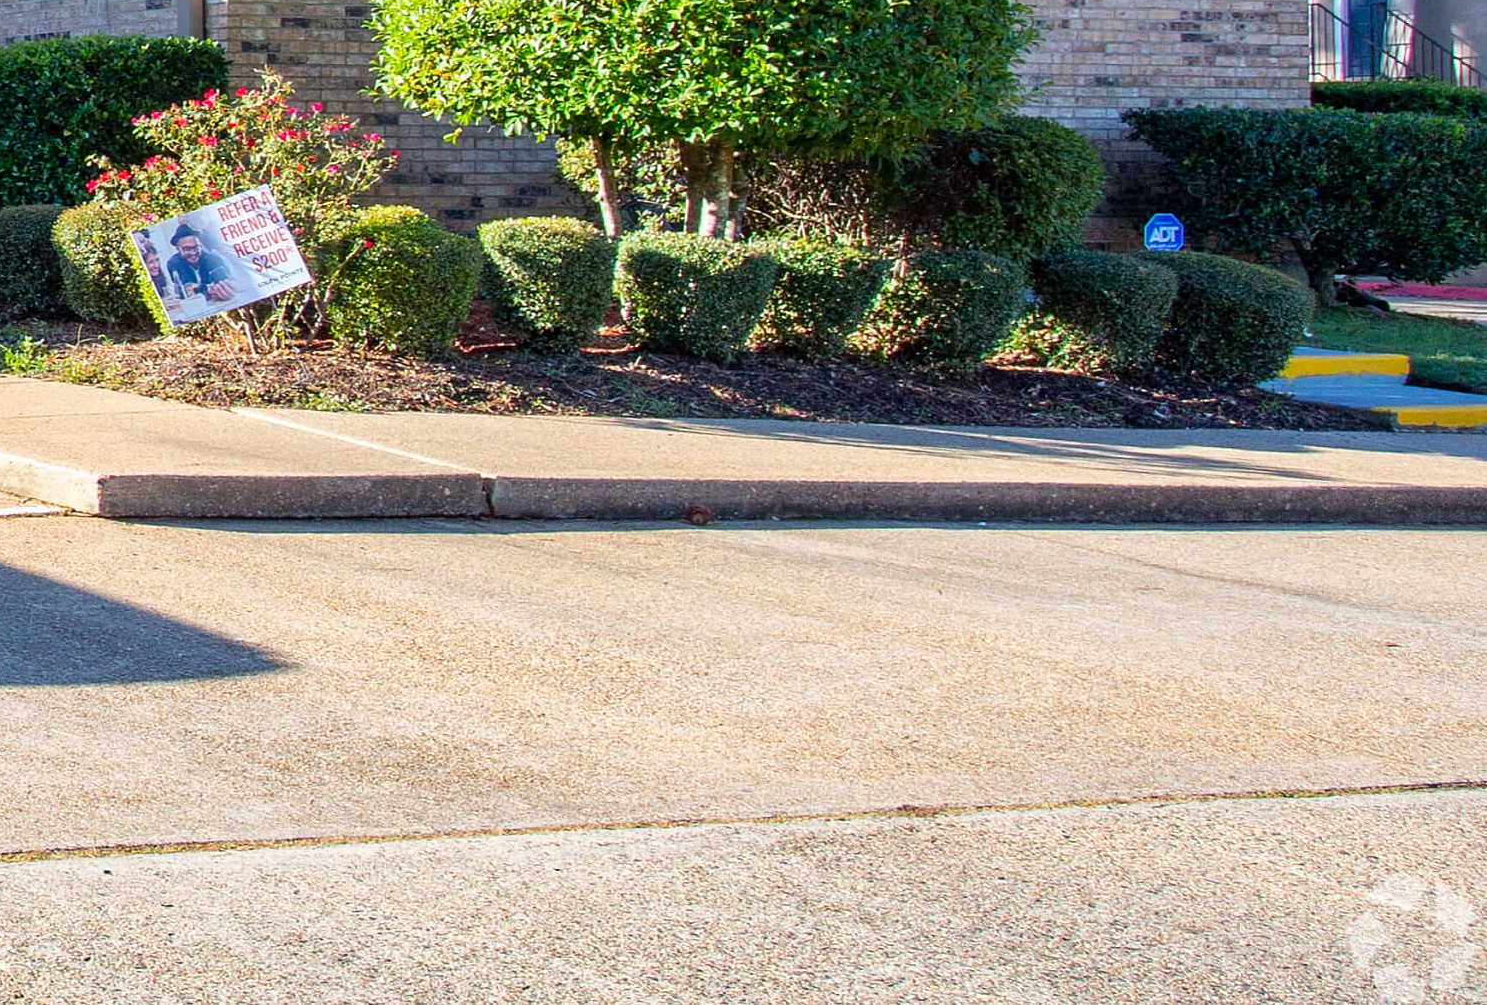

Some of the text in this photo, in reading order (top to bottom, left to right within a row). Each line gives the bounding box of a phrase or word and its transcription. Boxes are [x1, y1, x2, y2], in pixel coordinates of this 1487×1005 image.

[217, 191, 272, 222] REFER A
[220, 209, 280, 242] FRIEND &
[1149, 226, 1179, 243] ADT
[233, 226, 289, 259] RECEIVE
